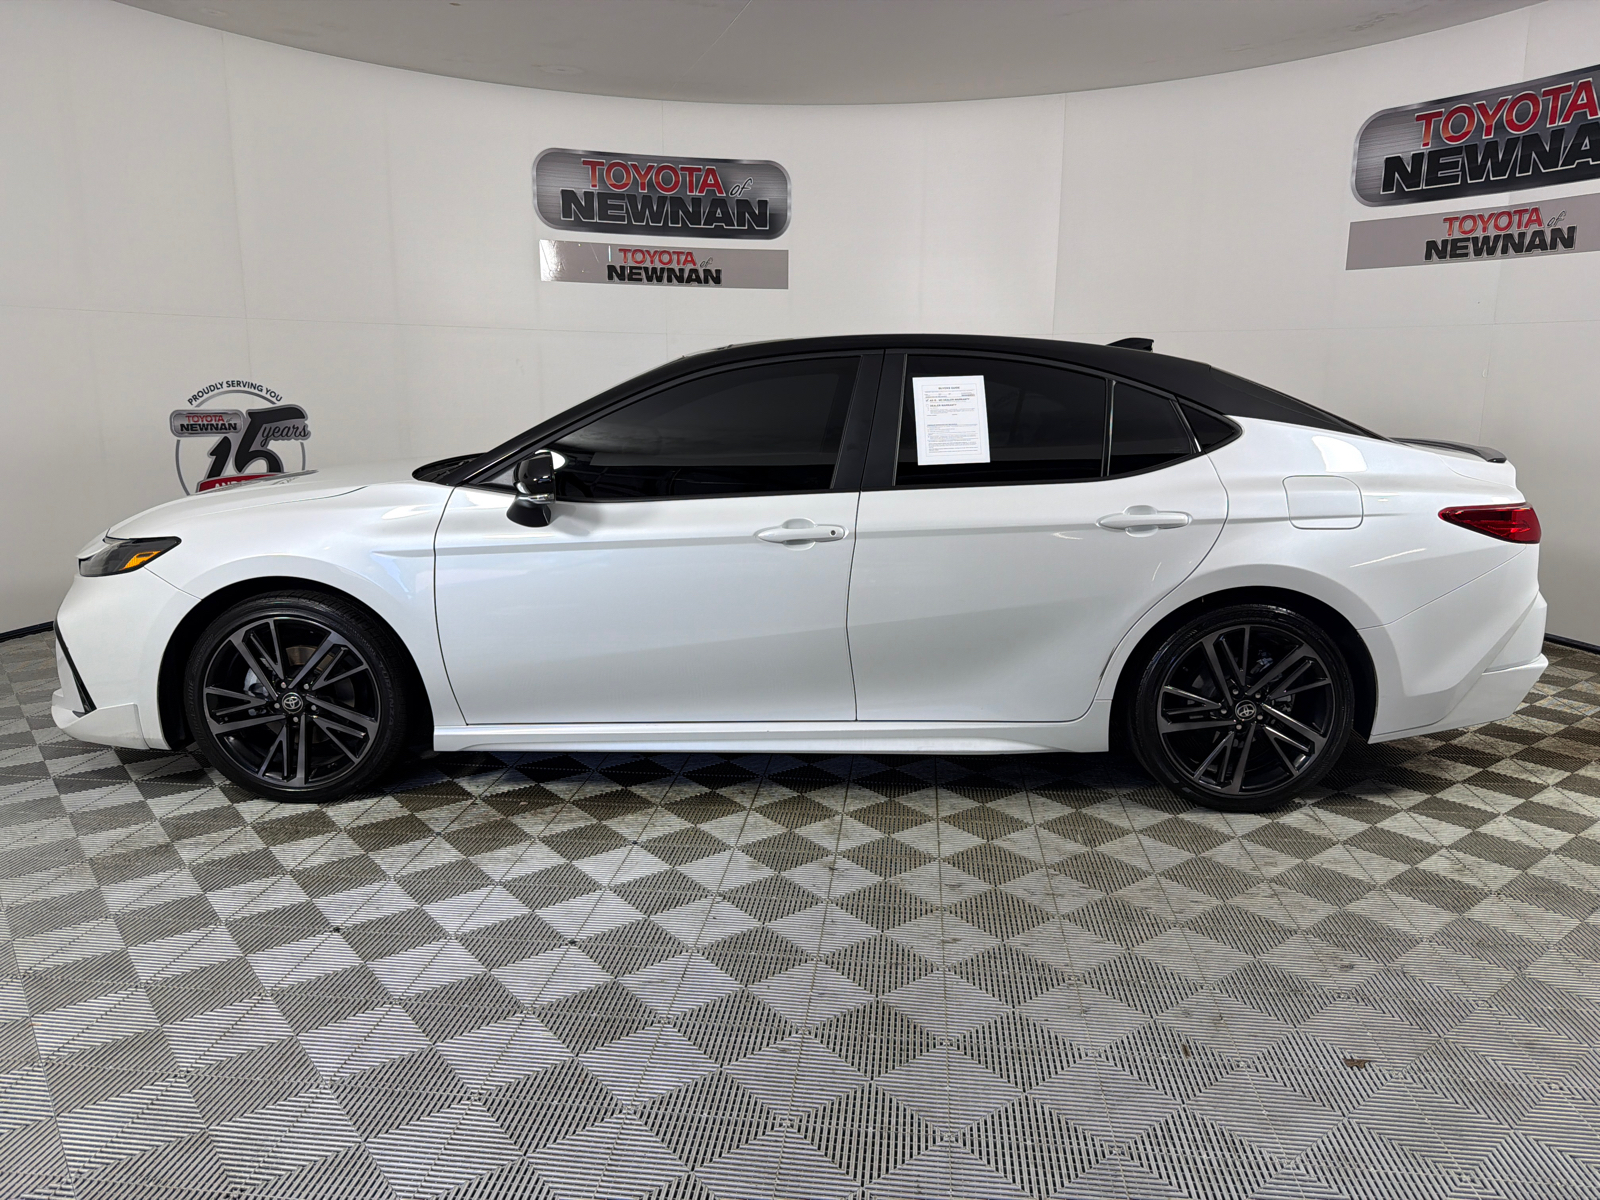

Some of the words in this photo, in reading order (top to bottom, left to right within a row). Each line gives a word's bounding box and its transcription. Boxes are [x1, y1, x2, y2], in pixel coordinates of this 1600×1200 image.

[1415, 78, 1600, 148] TOYOTA
[581, 158, 725, 196] TOYOTA
[730, 178, 753, 197] of
[560, 189, 770, 230] NEWNAN
[1443, 207, 1544, 237] TOYOTA
[1547, 210, 1567, 228] of
[618, 248, 697, 267] TOYOTA
[699, 257, 713, 268] of
[1424, 225, 1576, 262] NEWNAN
[607, 264, 722, 285] NEWNAN
[187, 381, 224, 406] PROUDLY
[226, 380, 264, 393] SERVING
[265, 387, 283, 403] YOU
[180, 422, 237, 432] NEWNAN
[185, 414, 225, 423] TOYOTA
[207, 406, 306, 480] 15
[260, 422, 309, 448] years
